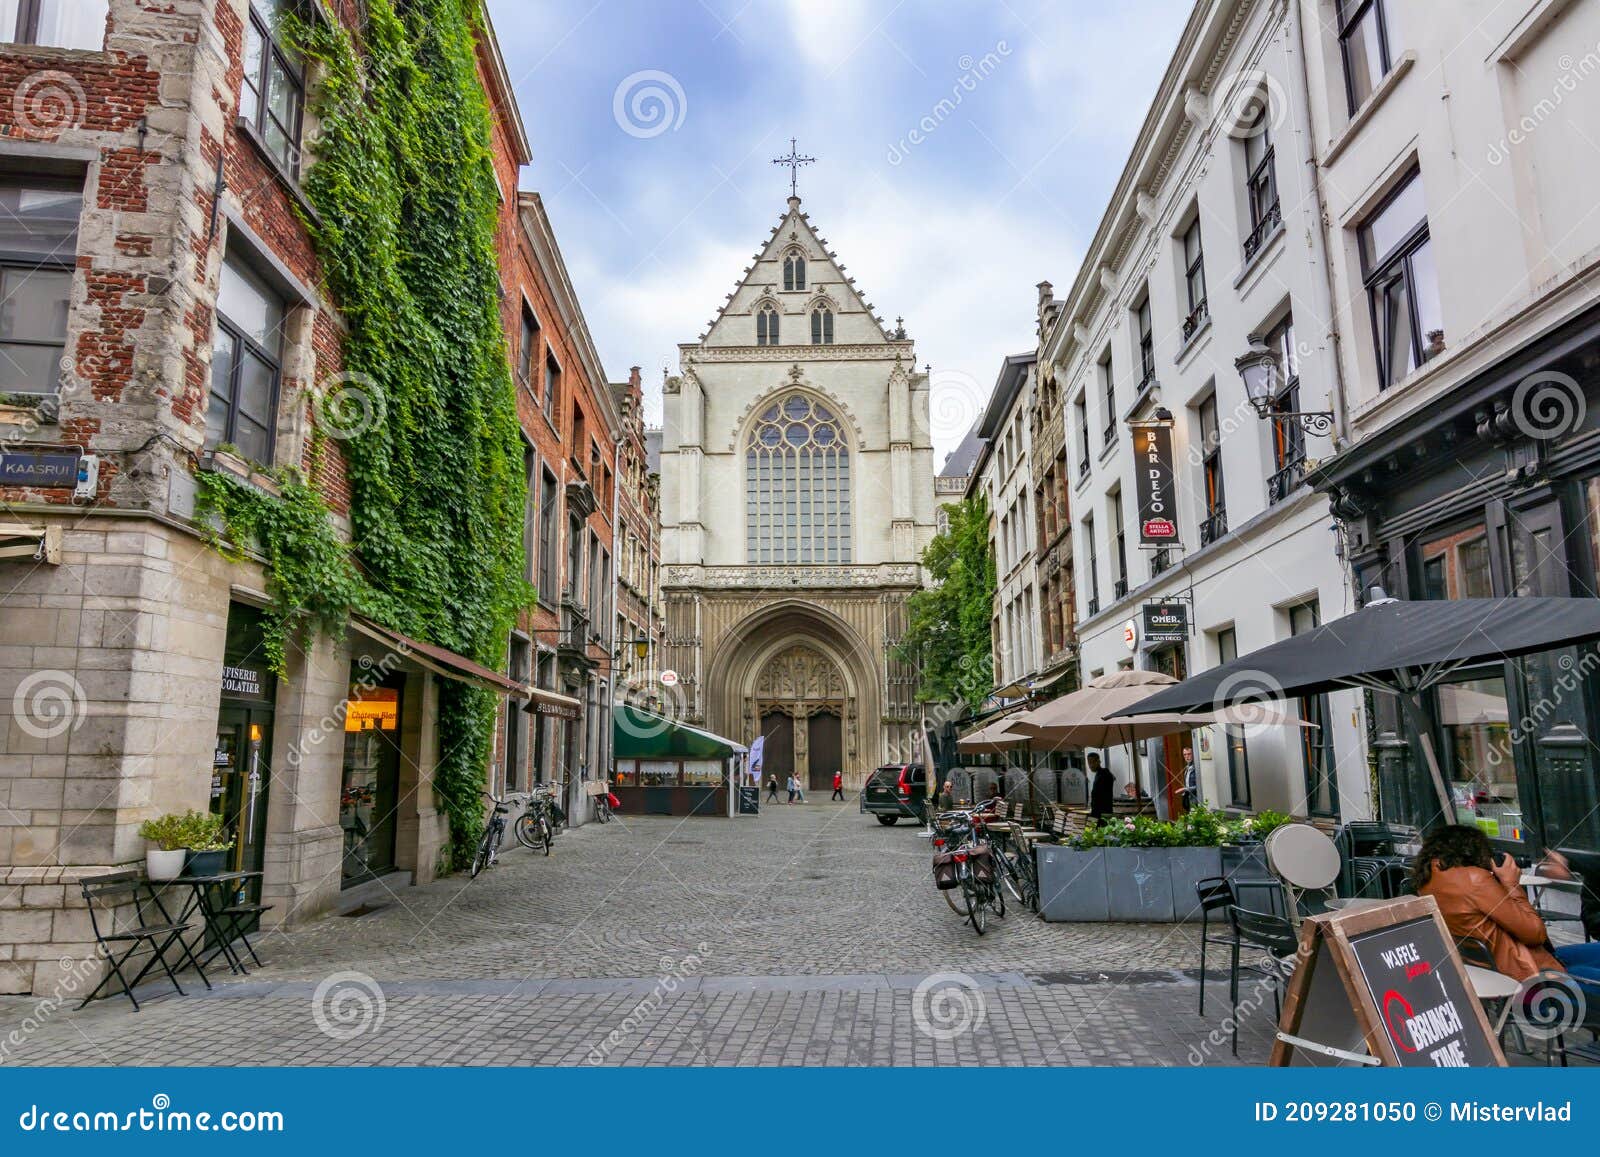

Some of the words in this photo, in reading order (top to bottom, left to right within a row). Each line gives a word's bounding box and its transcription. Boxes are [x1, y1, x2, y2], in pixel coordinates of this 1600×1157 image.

[1147, 432, 1159, 463] BAR
[6, 463, 69, 475] KAASRUI
[1149, 469, 1164, 512] DECO
[1381, 943, 1420, 969] WAFFLE
[1406, 1001, 1463, 1051] BRUNCH
